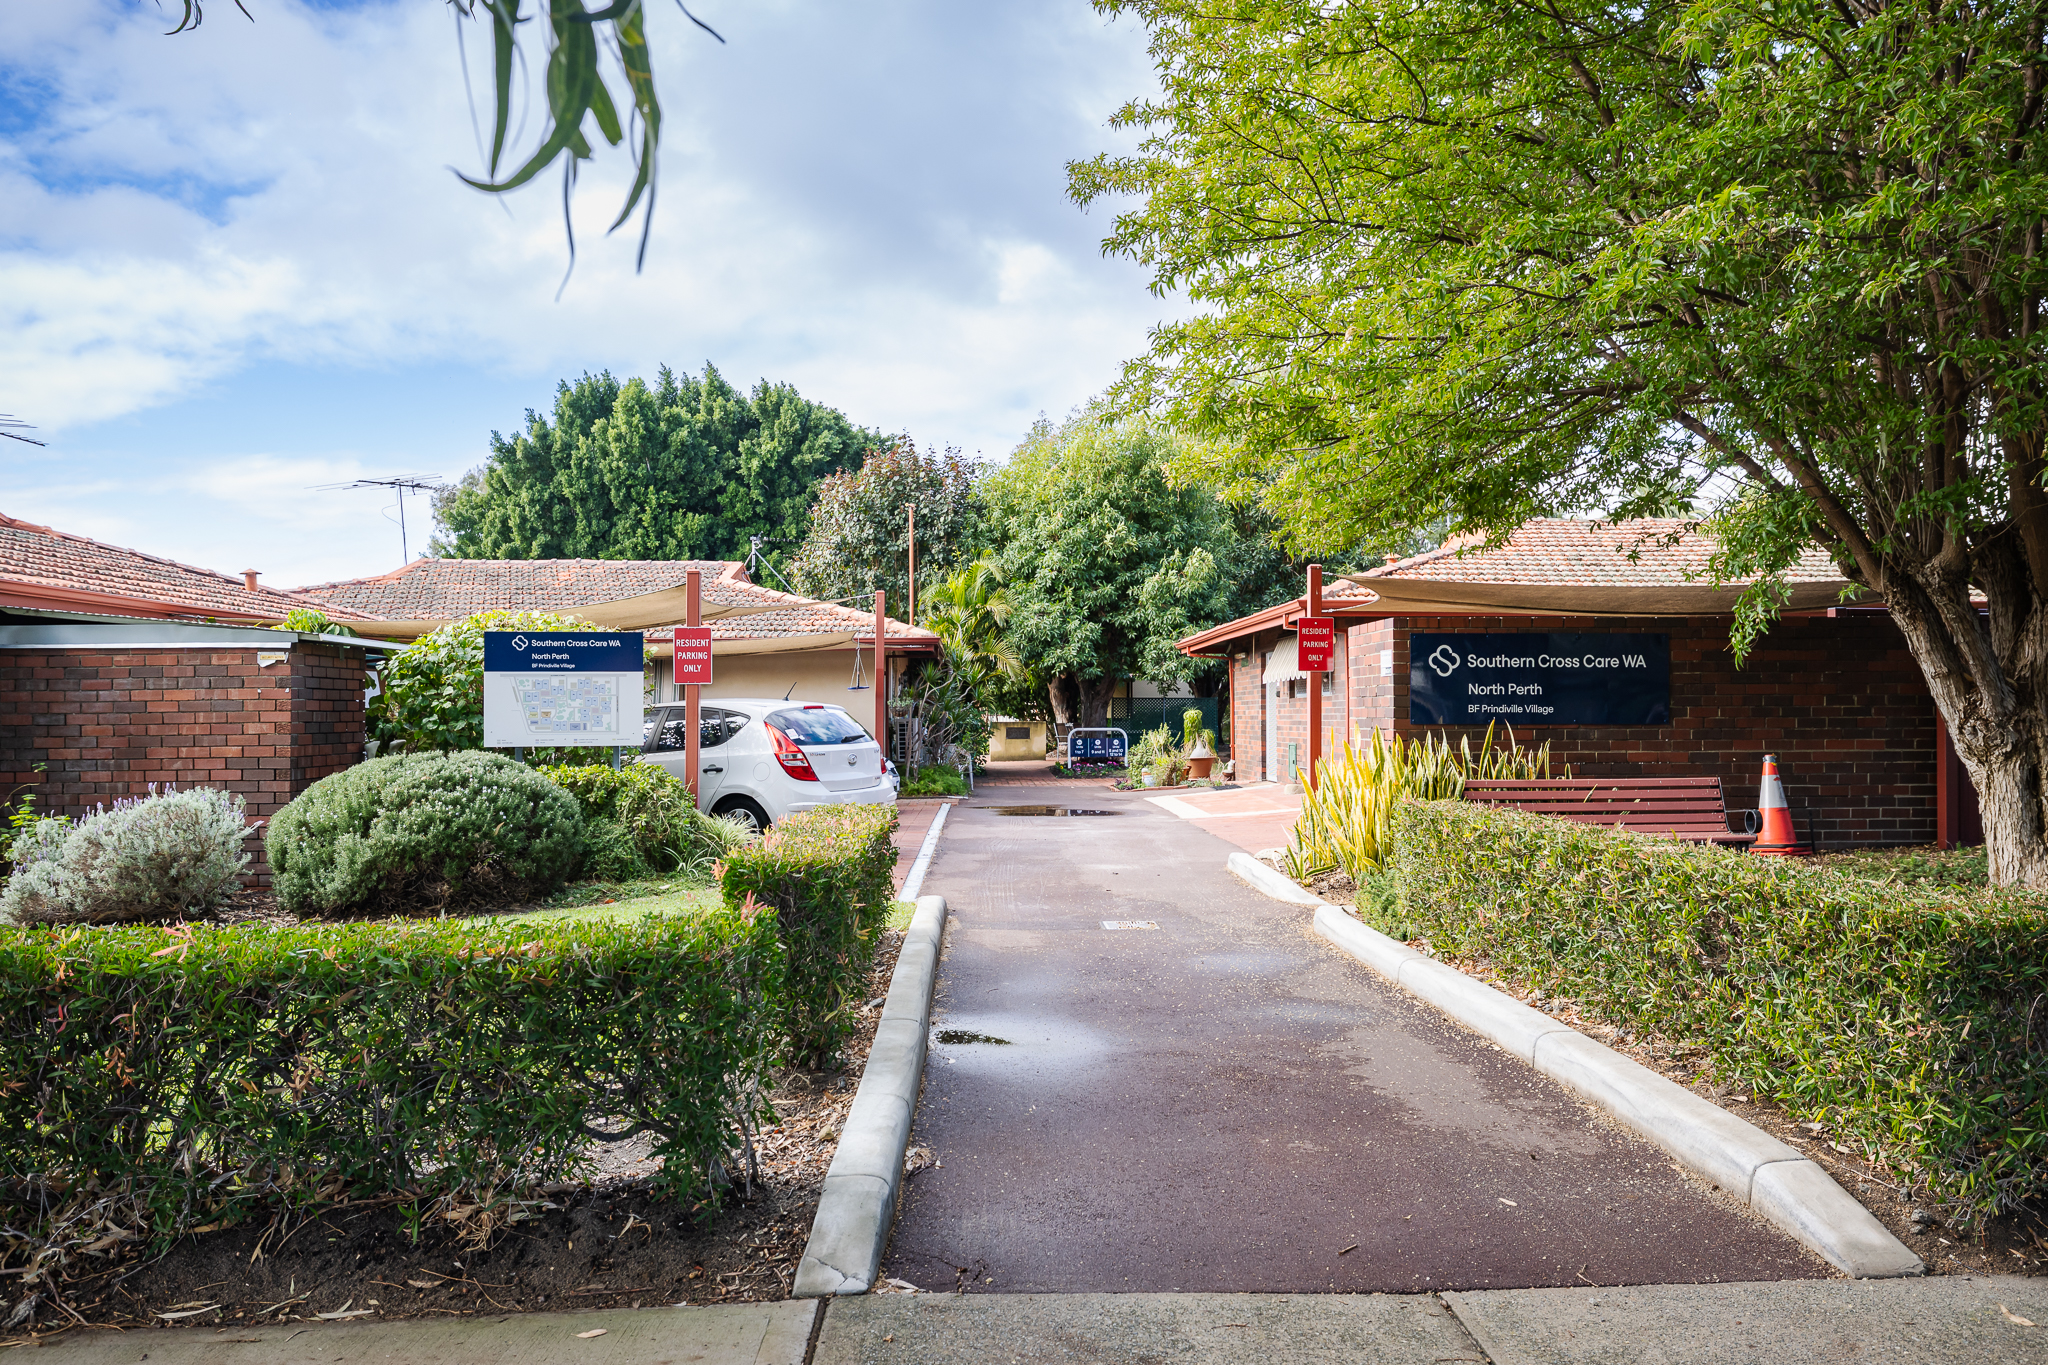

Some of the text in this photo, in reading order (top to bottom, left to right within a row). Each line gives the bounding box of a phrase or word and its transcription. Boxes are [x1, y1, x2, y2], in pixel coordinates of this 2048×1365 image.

[1467, 654, 1646, 668] Southern Cross Care WA
[1468, 684, 1542, 695] North Perth
[1482, 705, 1522, 713] Prindiville
[1524, 705, 1554, 715] Village
